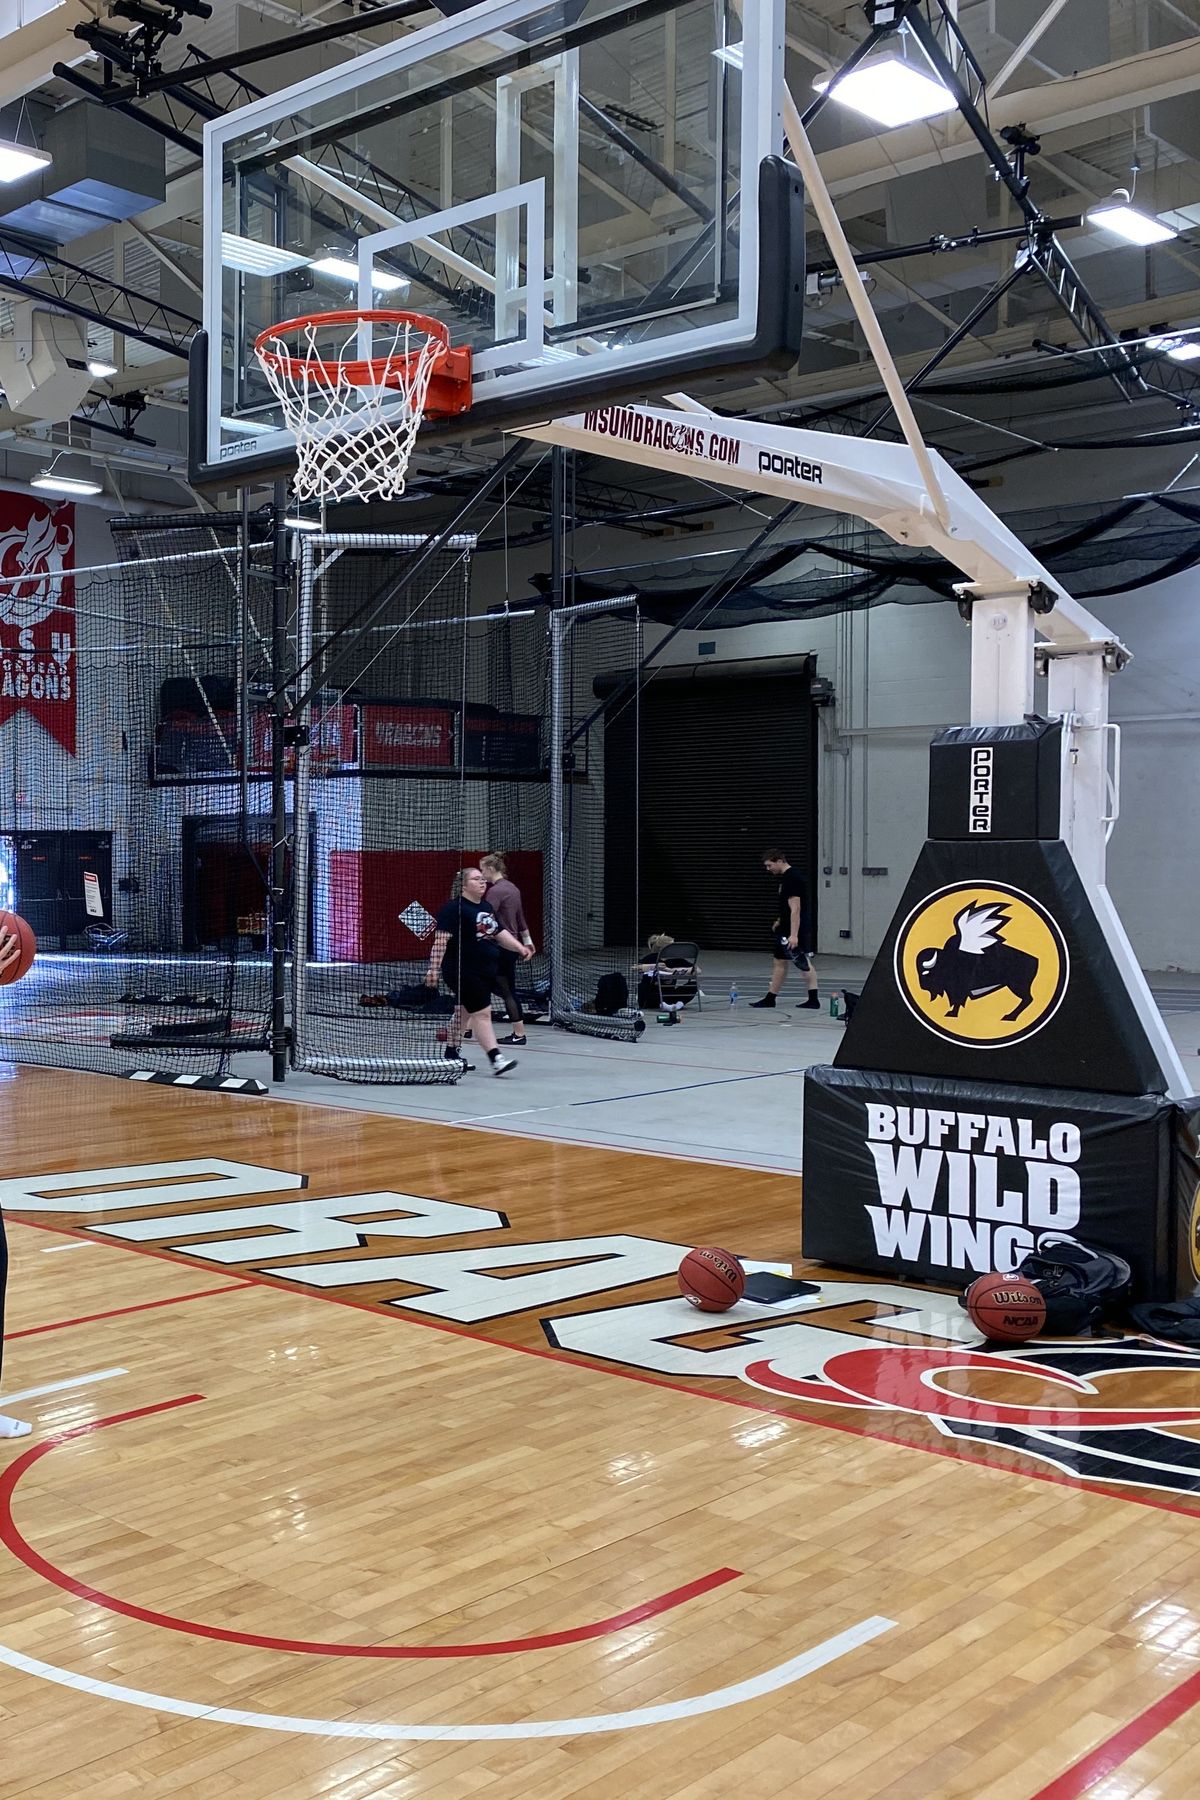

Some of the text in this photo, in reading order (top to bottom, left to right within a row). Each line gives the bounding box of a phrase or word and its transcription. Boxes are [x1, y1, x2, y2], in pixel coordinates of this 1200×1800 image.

[864, 1102, 1082, 1163] BUFFALO
[864, 1141, 1082, 1231] WILD
[863, 1204, 1078, 1274] WING
[699, 1250, 738, 1284] Wilson
[992, 1291, 1042, 1306] Wilson
[1002, 1315, 1039, 1327] NCAA
